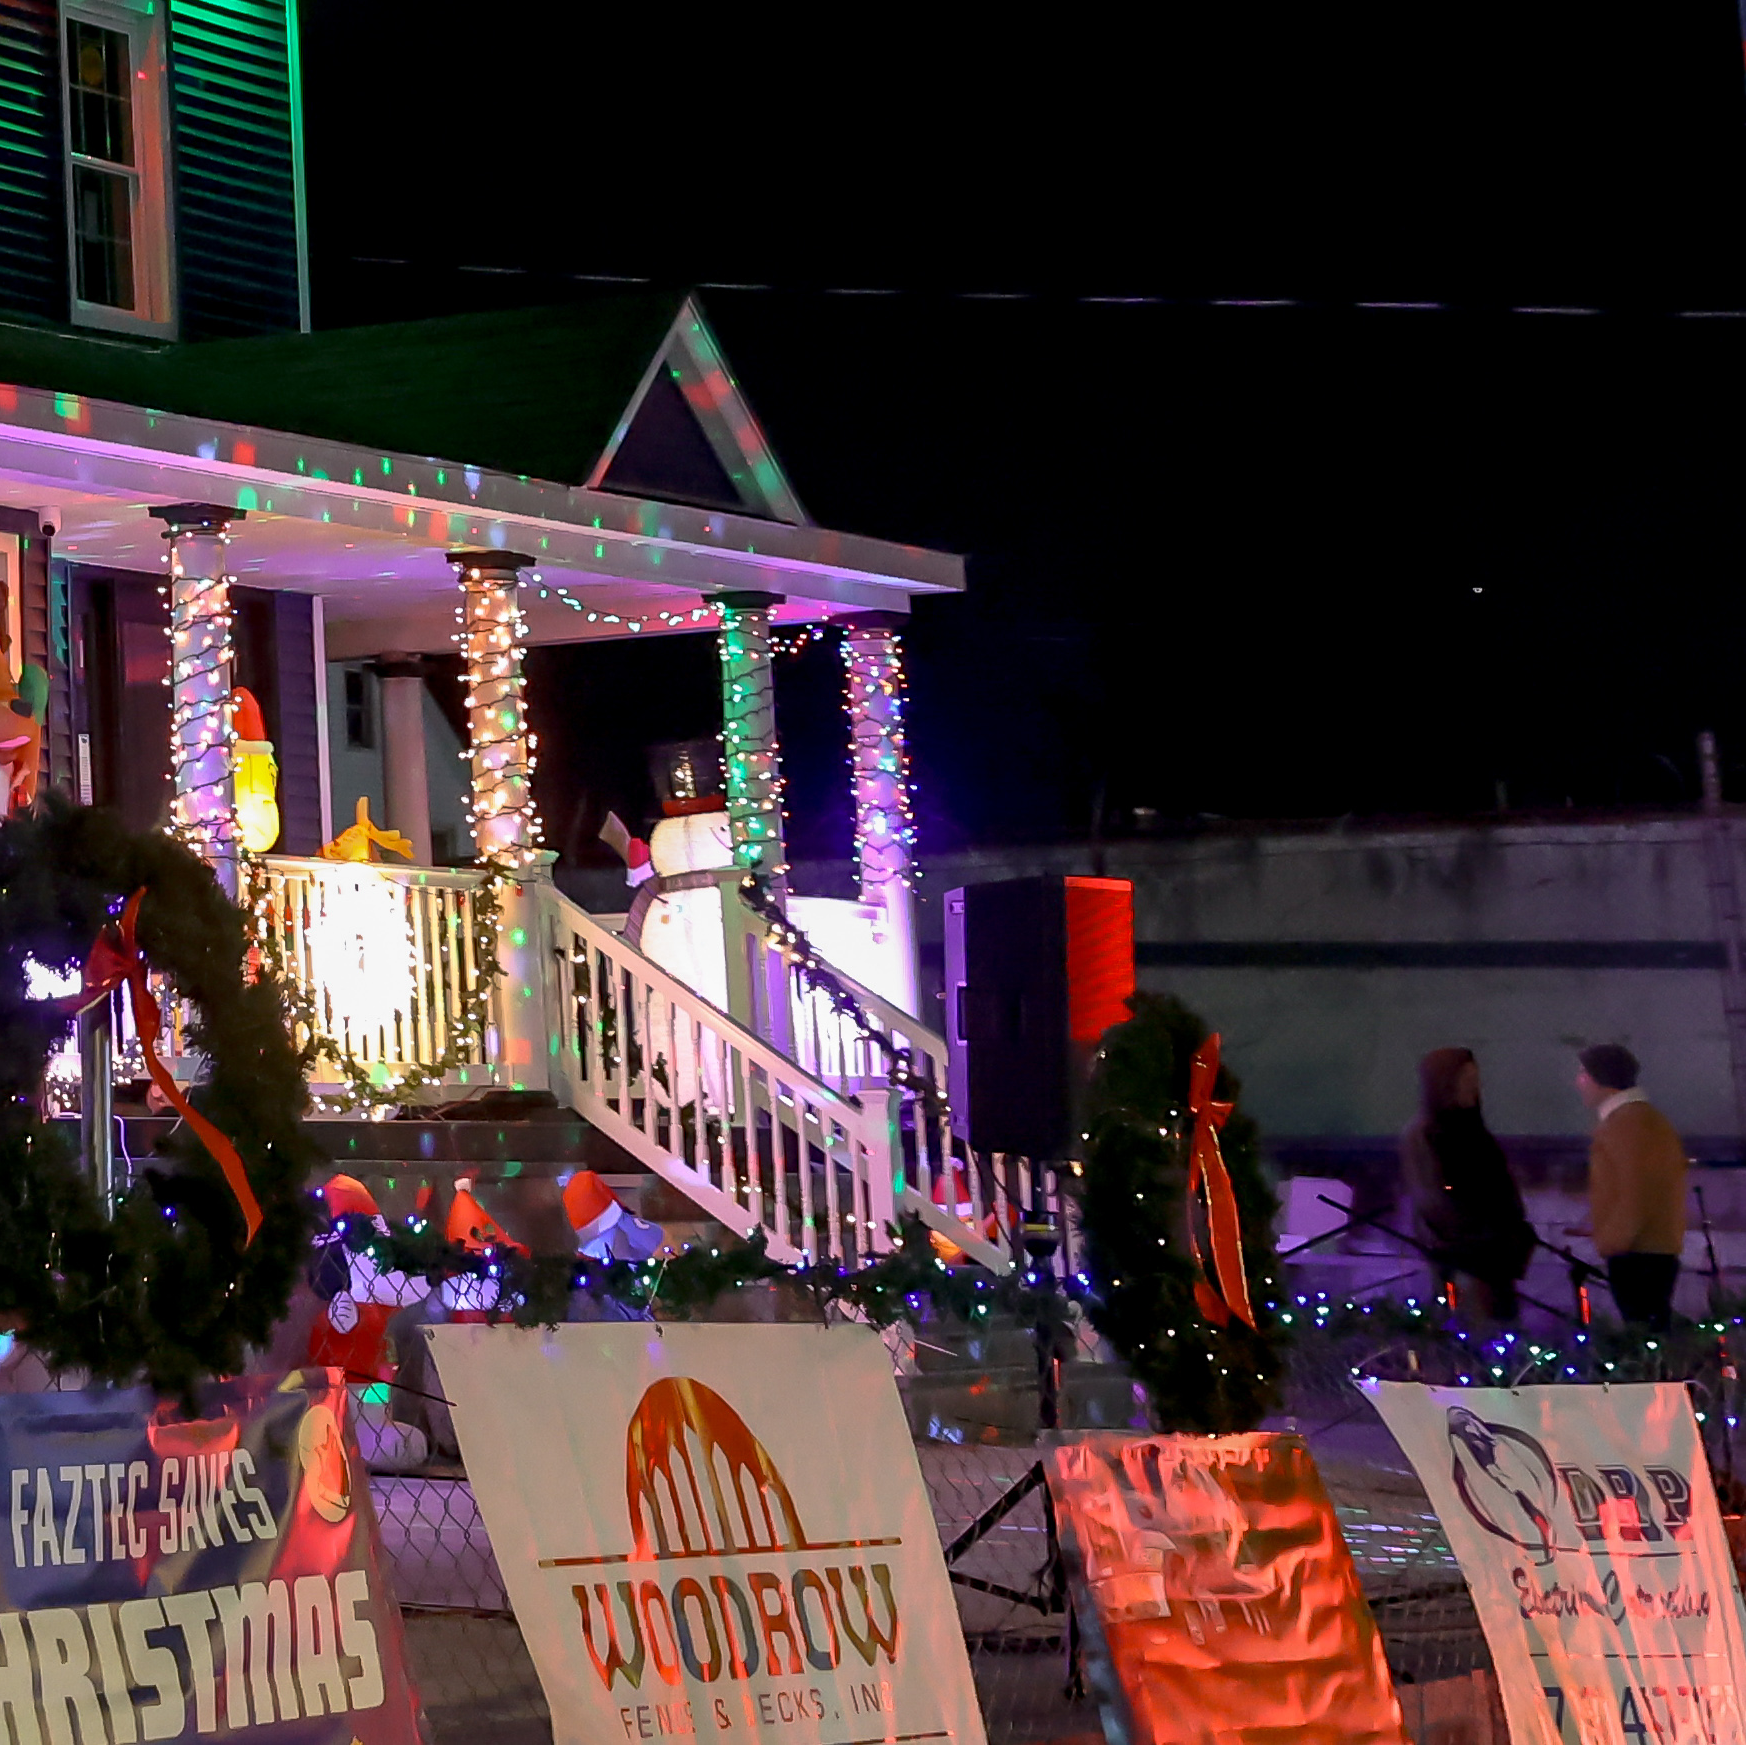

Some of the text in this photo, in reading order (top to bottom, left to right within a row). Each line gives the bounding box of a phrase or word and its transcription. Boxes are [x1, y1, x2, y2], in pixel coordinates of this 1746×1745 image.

[10, 1447, 279, 1569] FAZTEC SAVES
[571, 1563, 902, 1692] WOODROW
[714, 1698, 732, 1729] &
